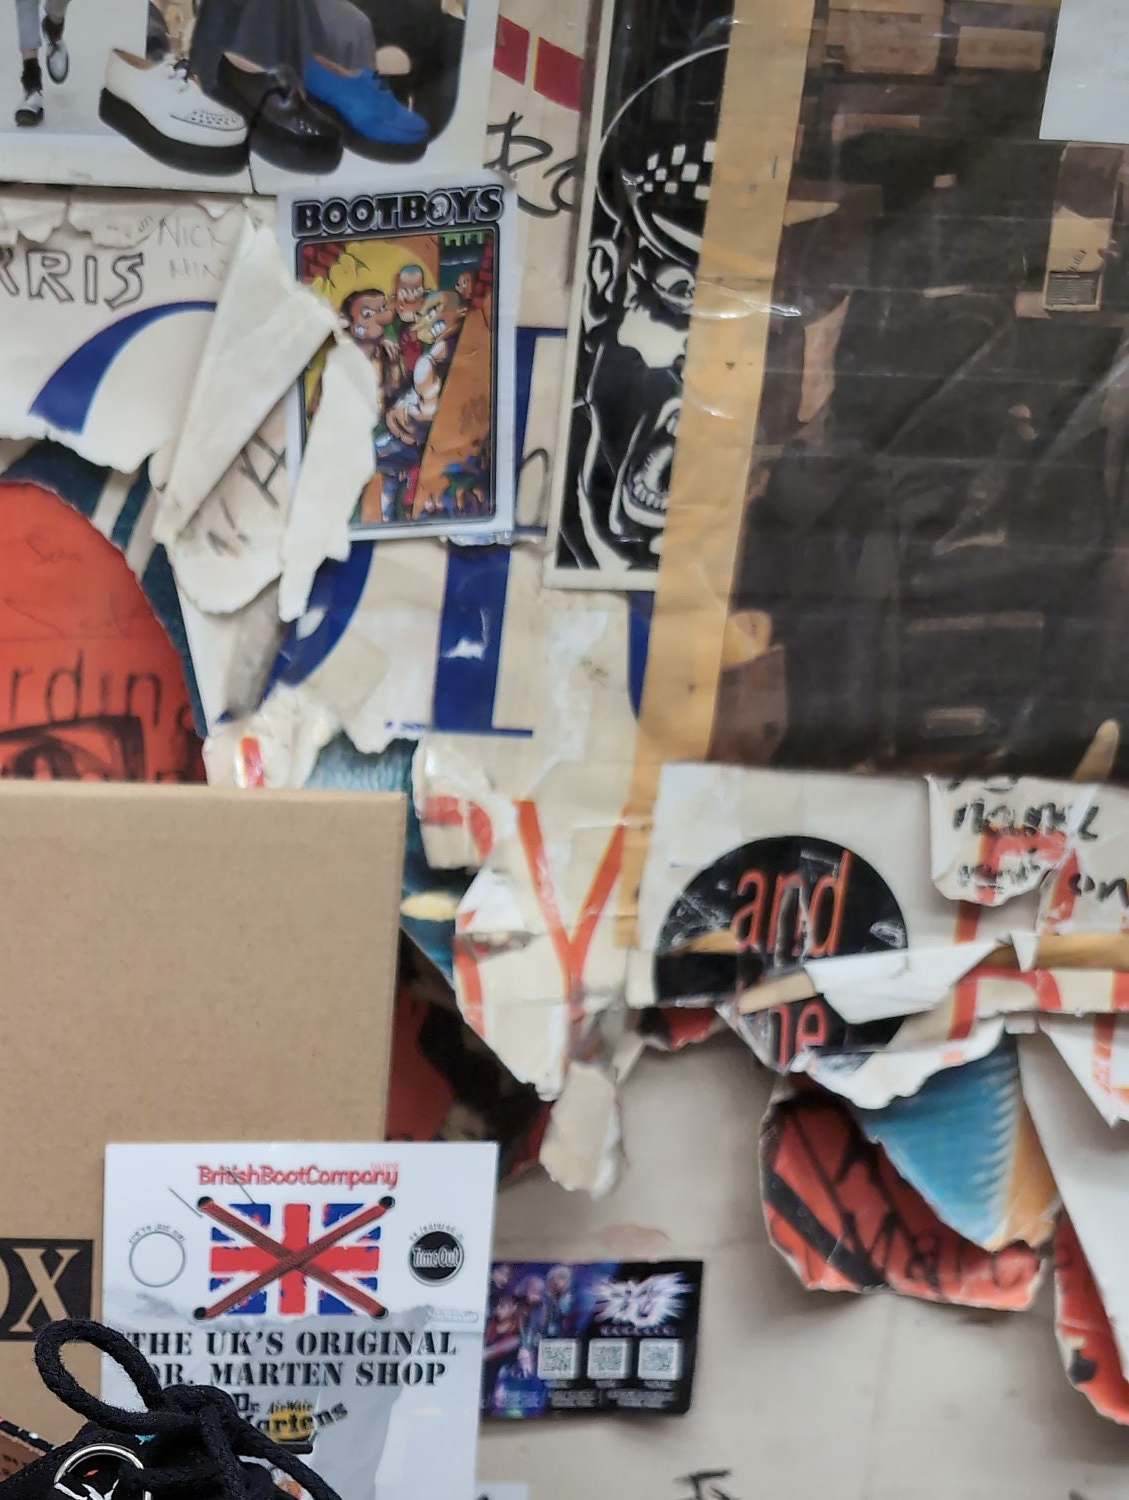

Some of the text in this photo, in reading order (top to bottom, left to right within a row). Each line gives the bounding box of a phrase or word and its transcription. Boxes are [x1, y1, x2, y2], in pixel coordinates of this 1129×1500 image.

[291, 184, 505, 239] BOOTBOYS
[196, 1163, 400, 1190] BritishBootCompany
[124, 1330, 457, 1357] THE UK'S ORIGINAL
[210, 1362, 342, 1387] MARTEN
[355, 1362, 447, 1387] SHOP
